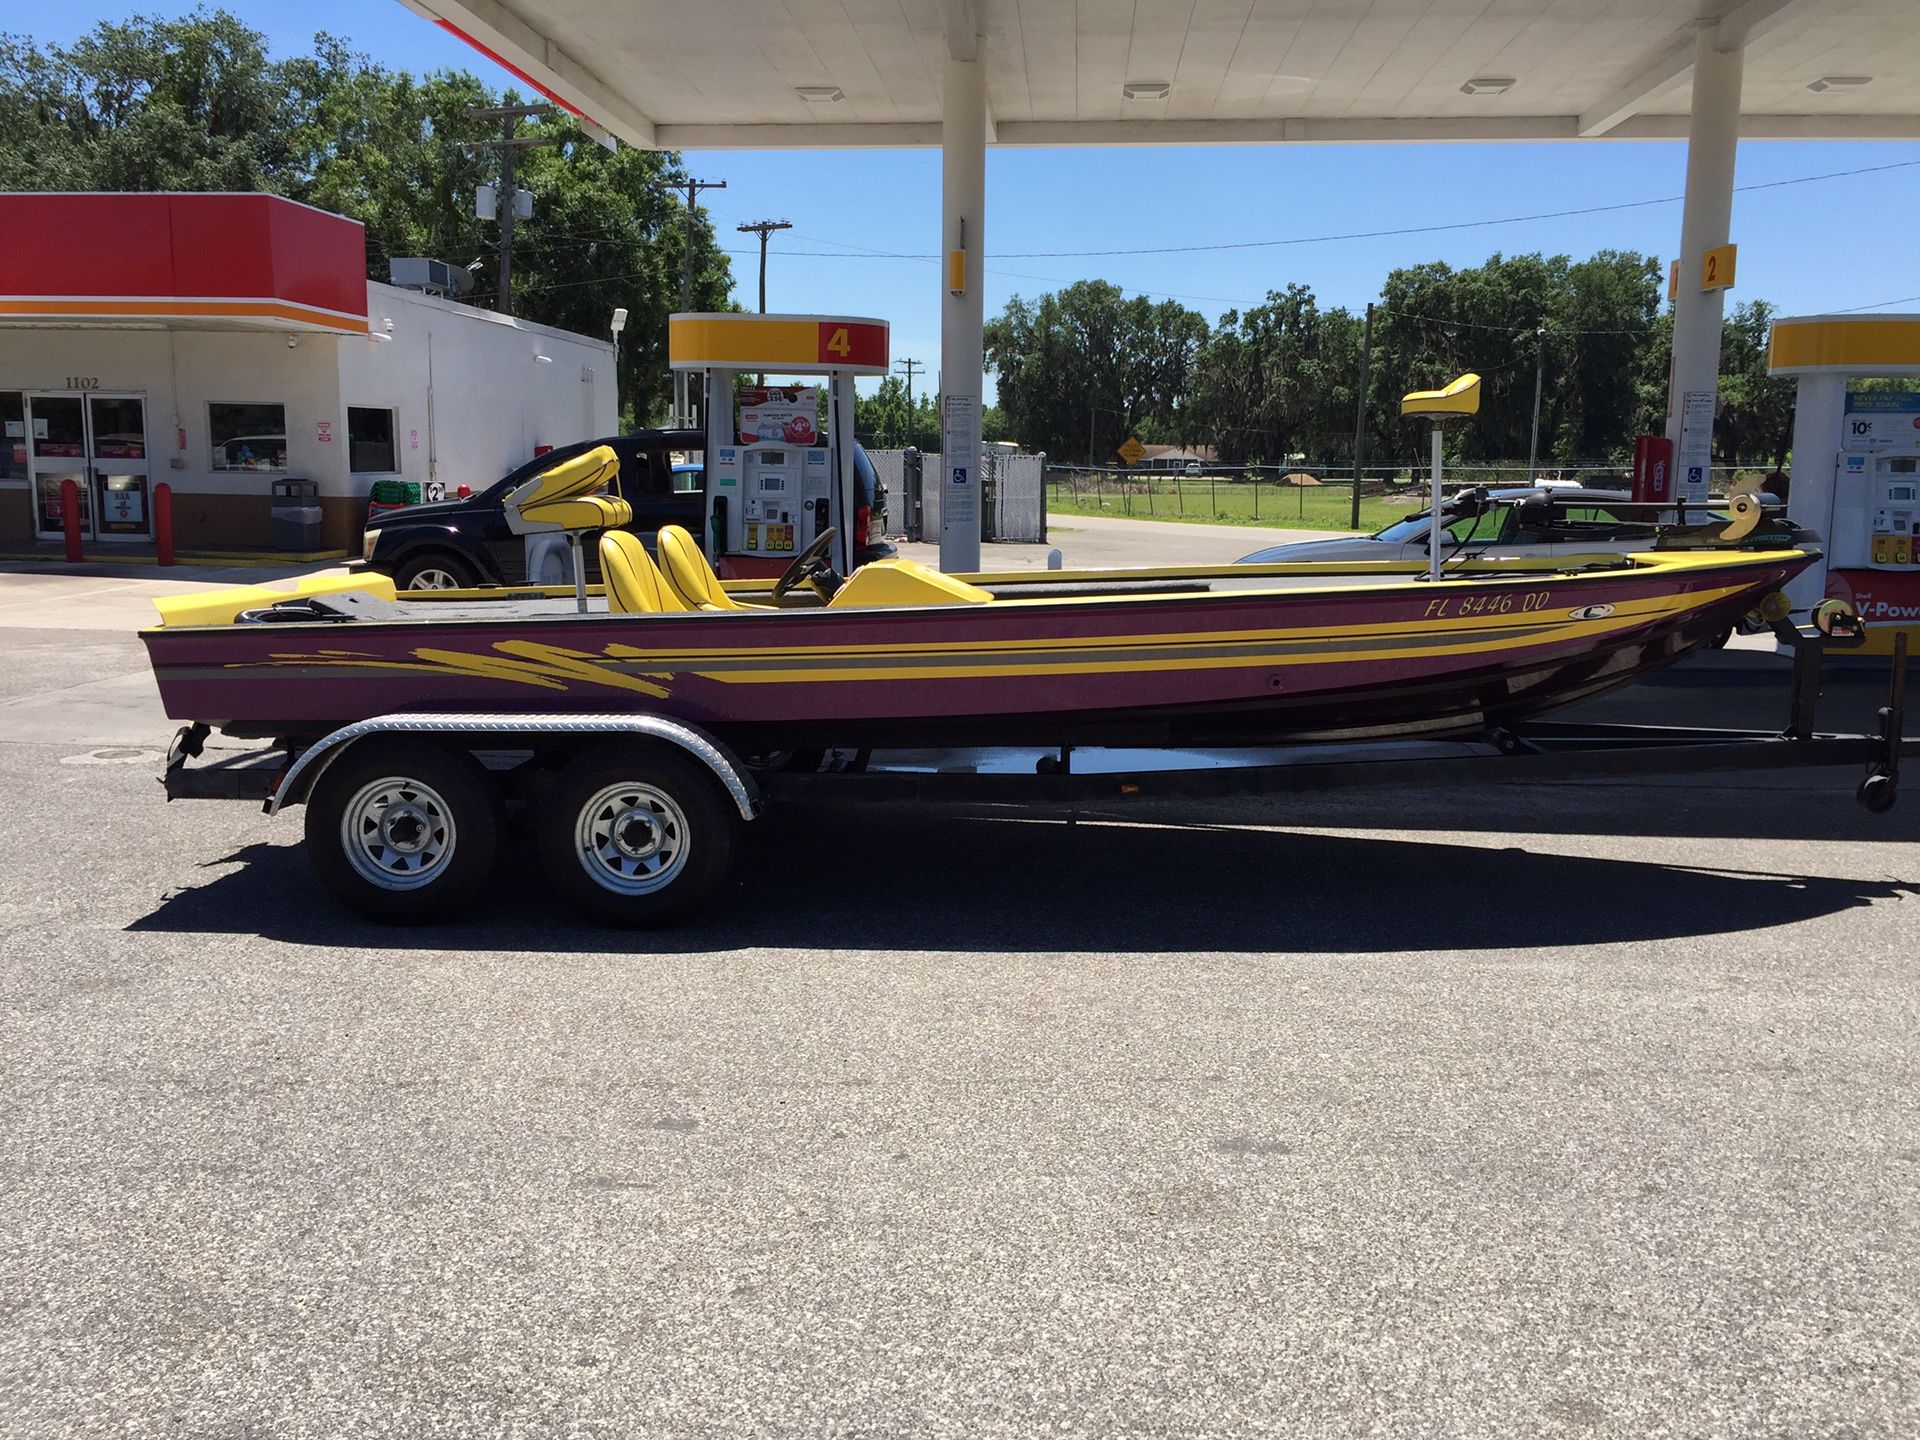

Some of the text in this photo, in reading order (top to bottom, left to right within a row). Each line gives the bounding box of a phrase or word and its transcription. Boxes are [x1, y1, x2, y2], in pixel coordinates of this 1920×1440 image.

[1707, 255, 1717, 282] 2
[827, 328, 851, 357] 4
[66, 377, 100, 389] 1102
[1424, 598, 1450, 617] FL
[1459, 593, 1513, 615] 8446
[1855, 592, 1872, 600] Shell
[1855, 601, 1920, 618] V-Pow
